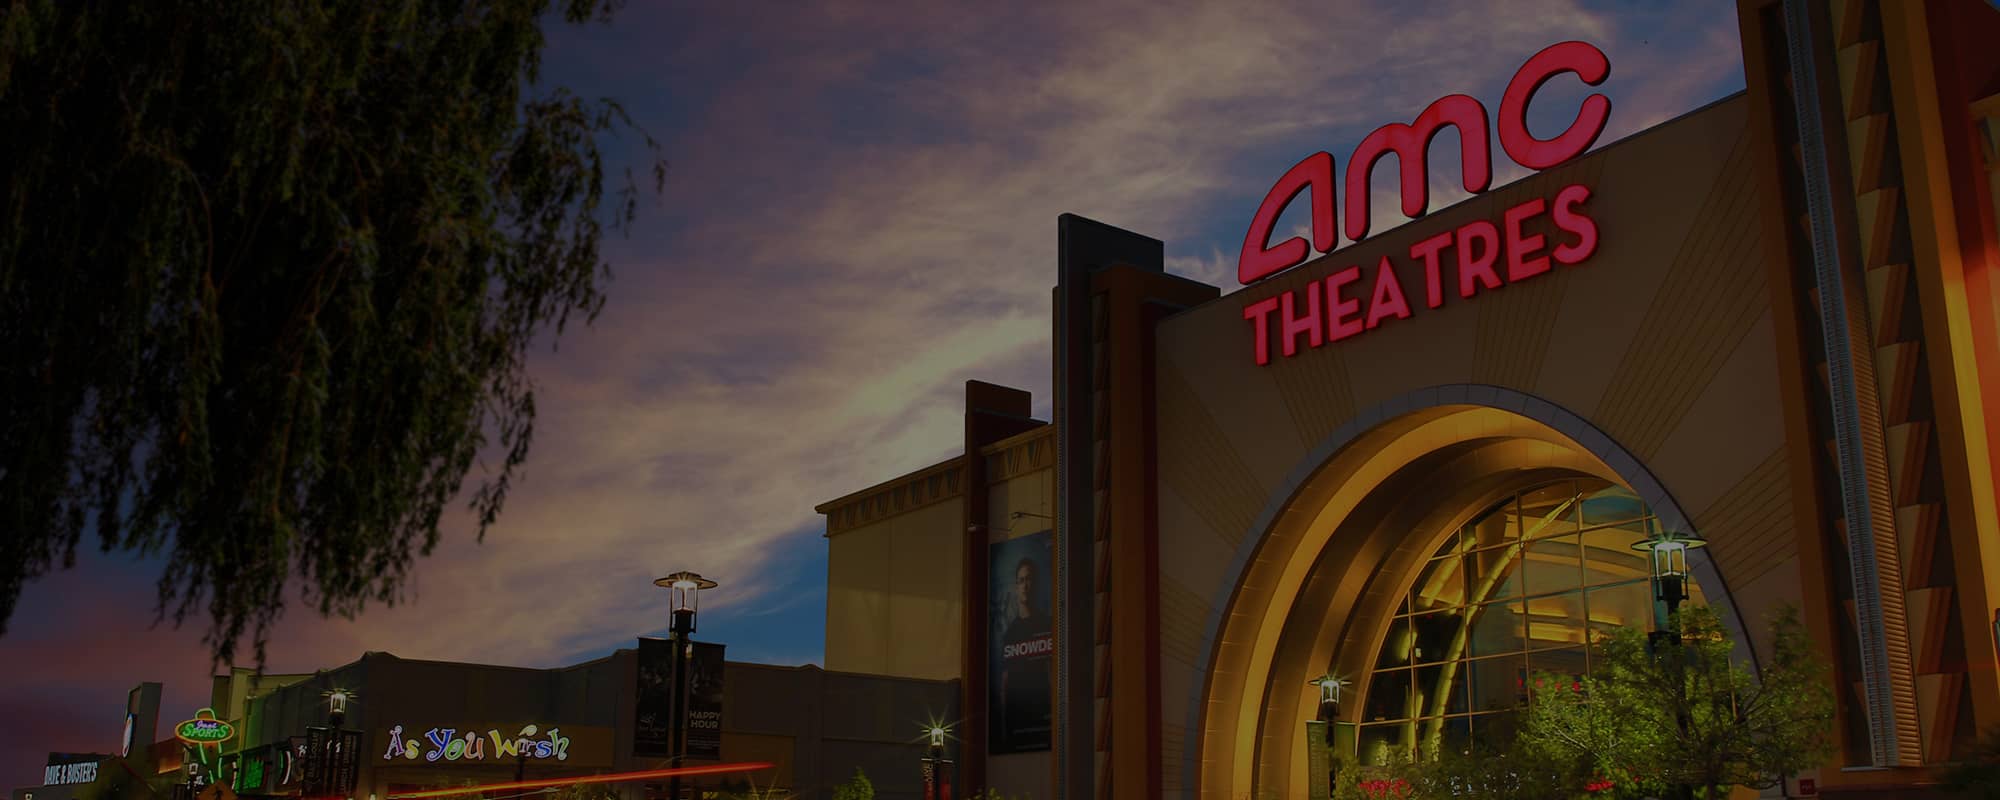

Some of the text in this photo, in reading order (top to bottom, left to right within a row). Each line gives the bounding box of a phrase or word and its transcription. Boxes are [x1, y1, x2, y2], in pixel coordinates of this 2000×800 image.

[1243, 183, 1600, 366] THEATRES
[689, 711, 721, 720] HAPPY
[690, 720, 719, 729] HOUR
[384, 724, 570, 762] As You Wish
[44, 764, 62, 785] DAVE
